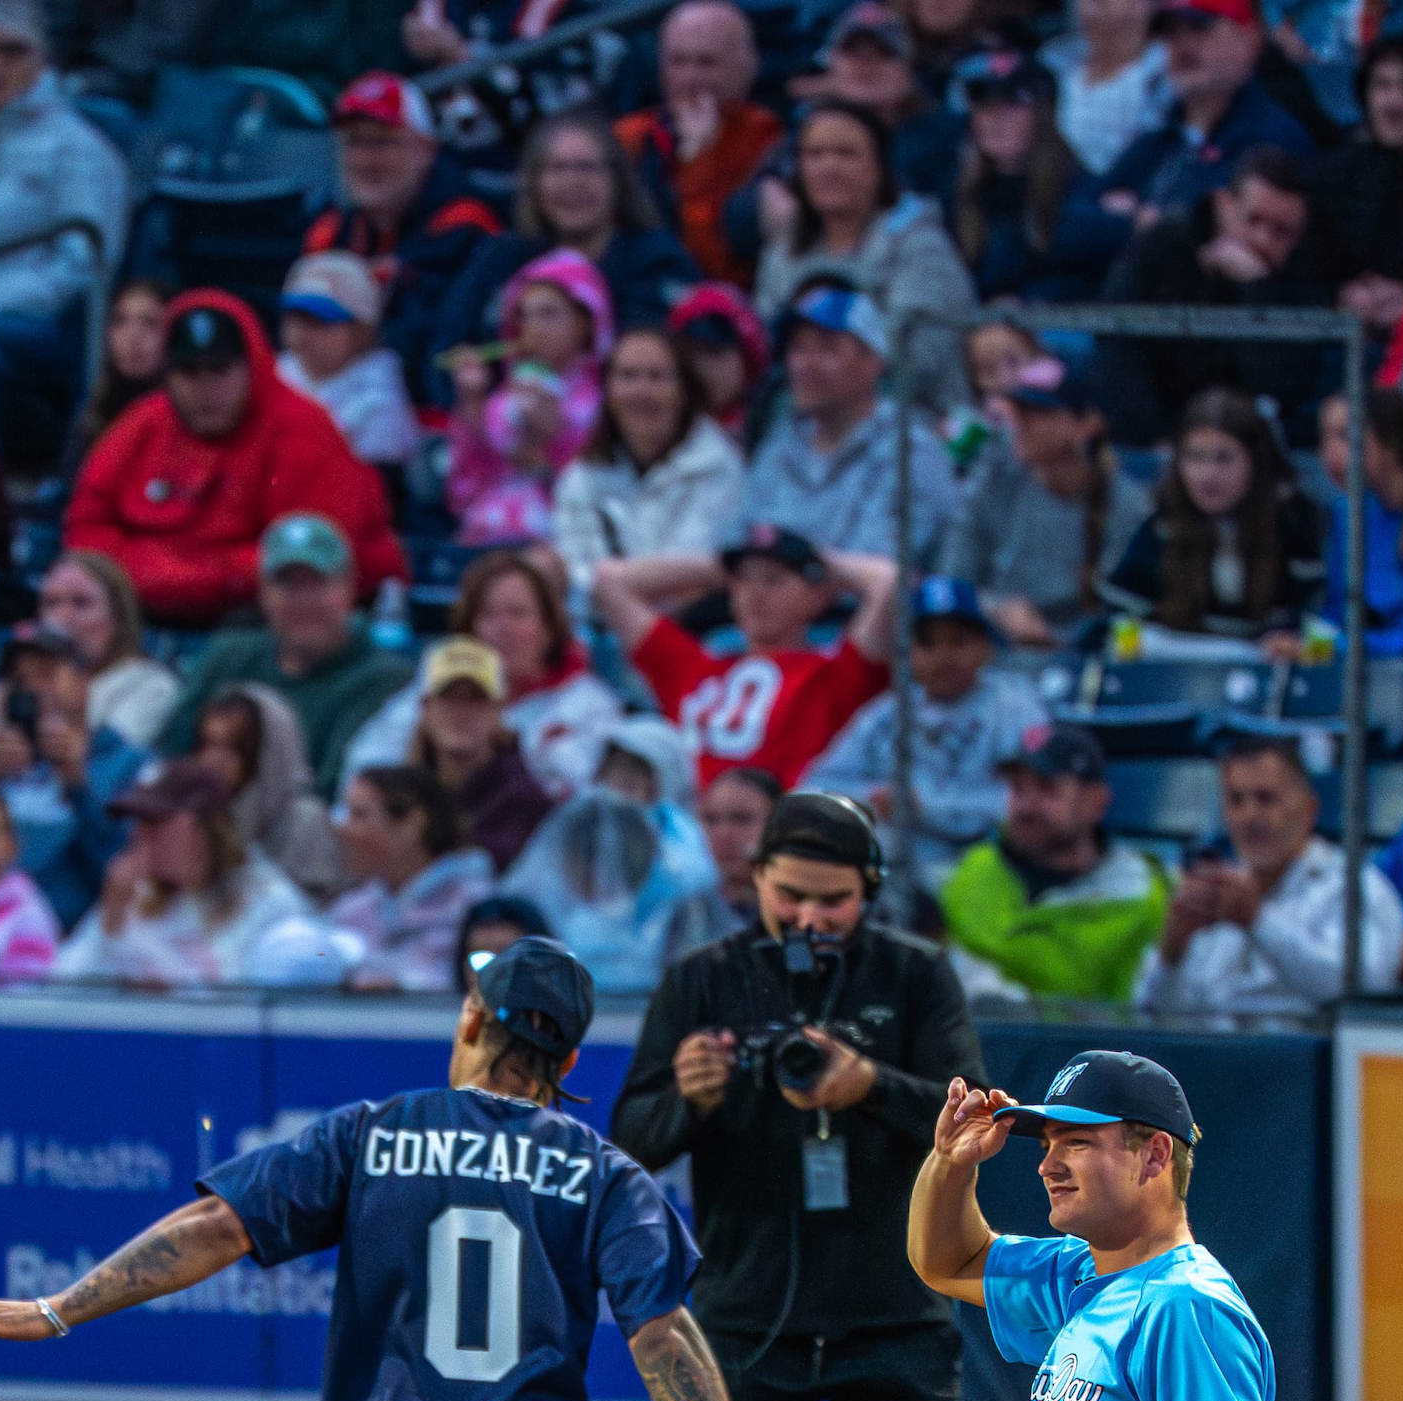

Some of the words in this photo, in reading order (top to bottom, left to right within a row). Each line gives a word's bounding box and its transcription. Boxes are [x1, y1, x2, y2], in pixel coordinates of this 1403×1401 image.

[24, 1131, 172, 1190] Health
[364, 1126, 592, 1205] GONZALEZ
[424, 1207, 520, 1382] 0
